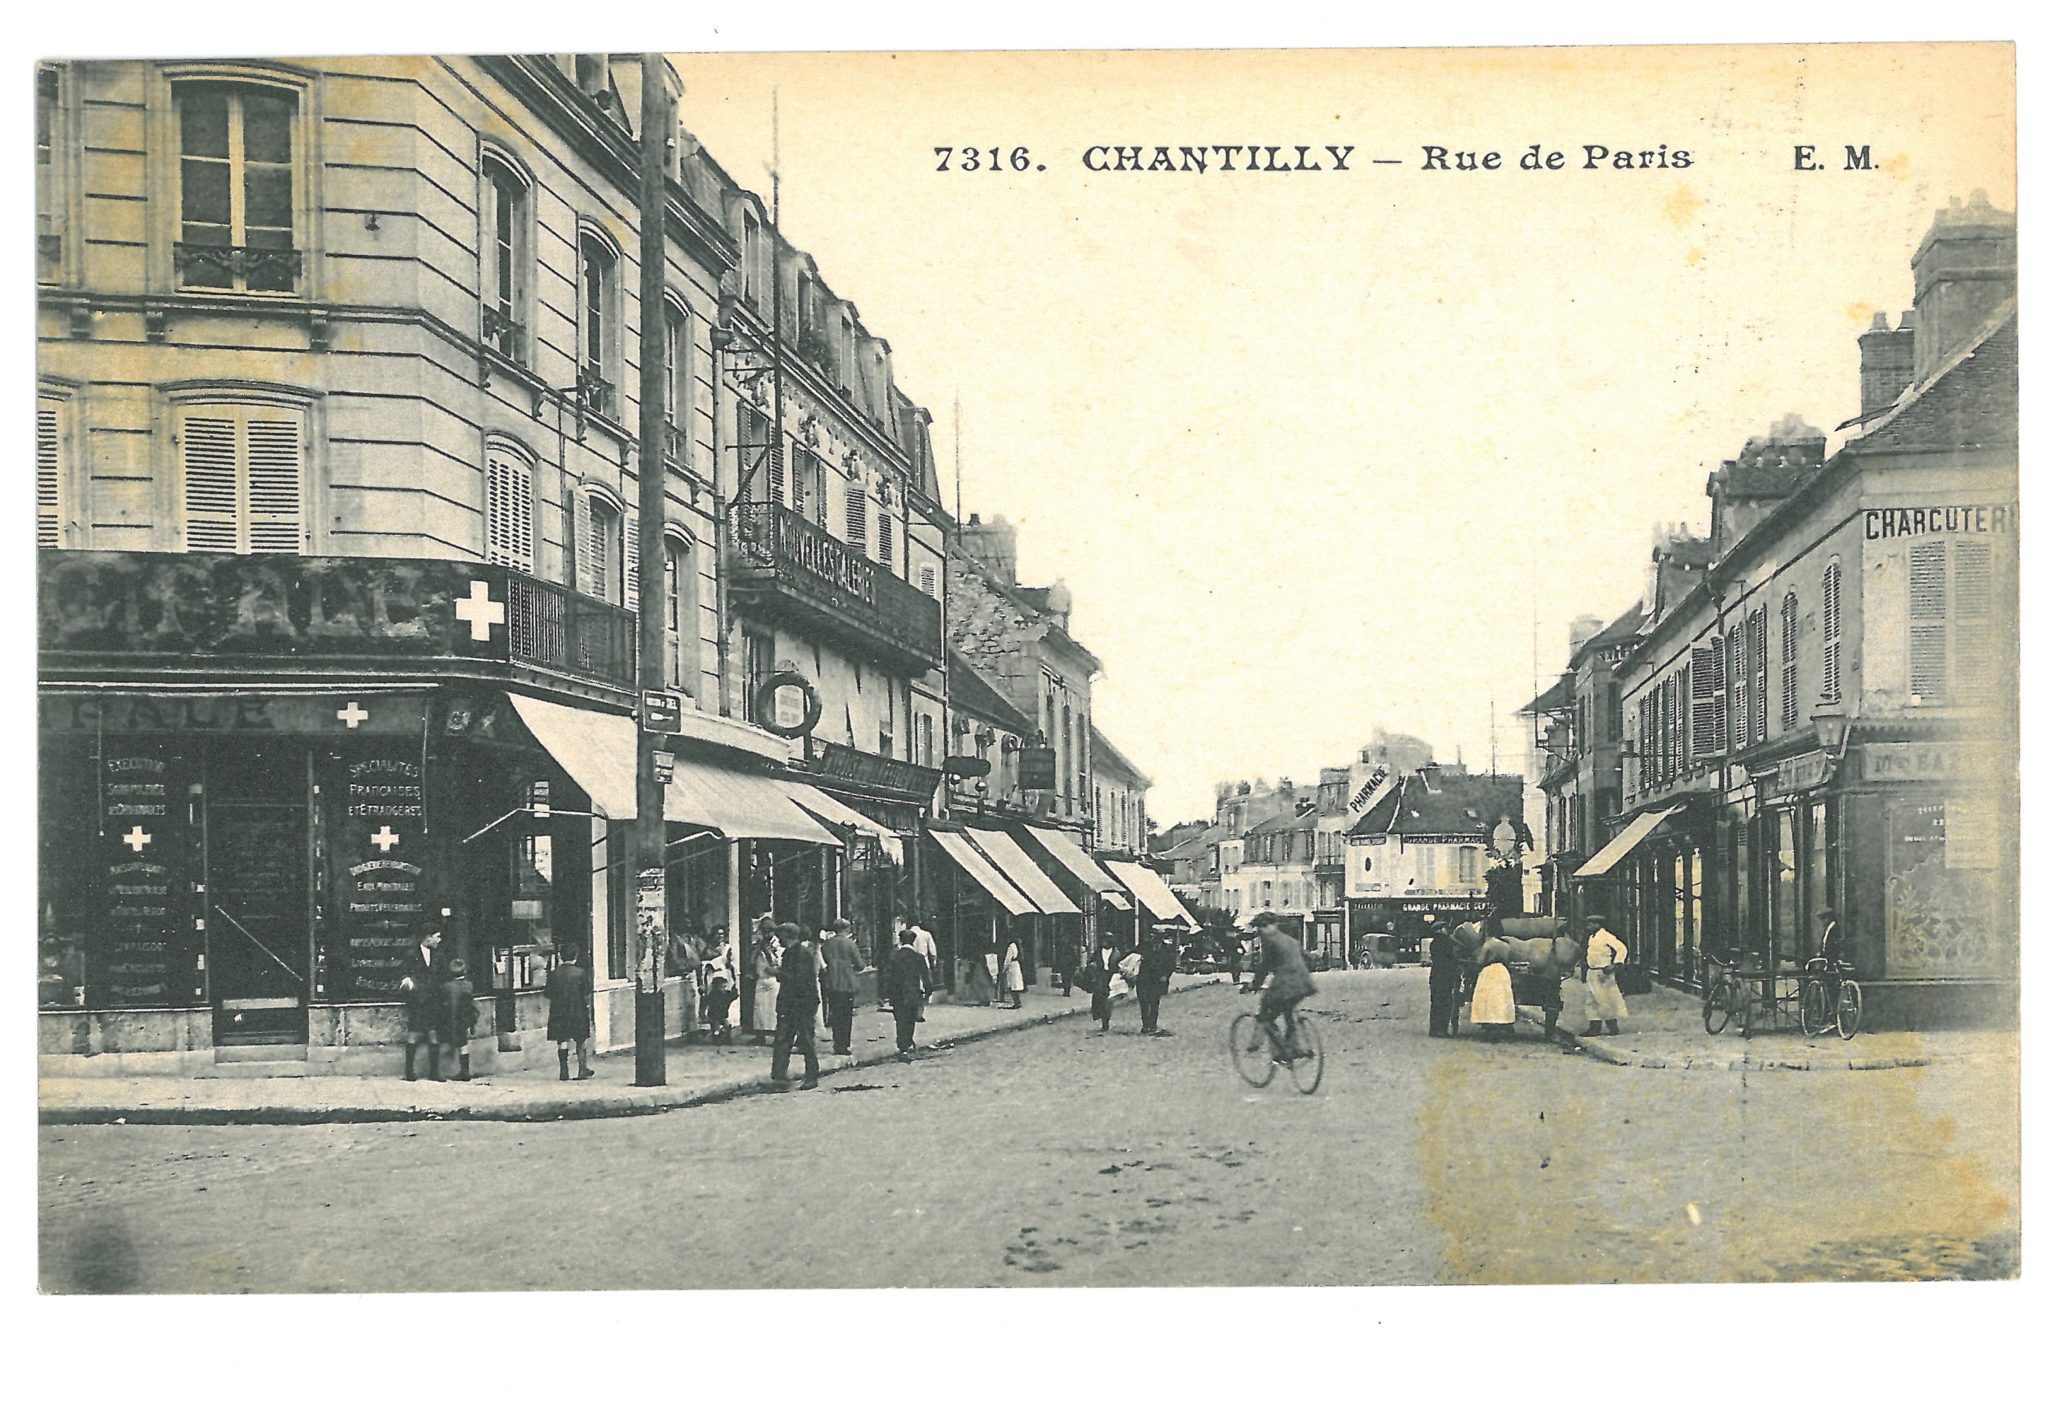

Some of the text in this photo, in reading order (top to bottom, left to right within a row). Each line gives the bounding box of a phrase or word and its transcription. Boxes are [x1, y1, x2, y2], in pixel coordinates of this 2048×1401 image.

[1349, 766, 1389, 813] PHARMACIE
[1402, 903, 1430, 912] GRANDE
[1433, 902, 1471, 911] PHARMACIE
